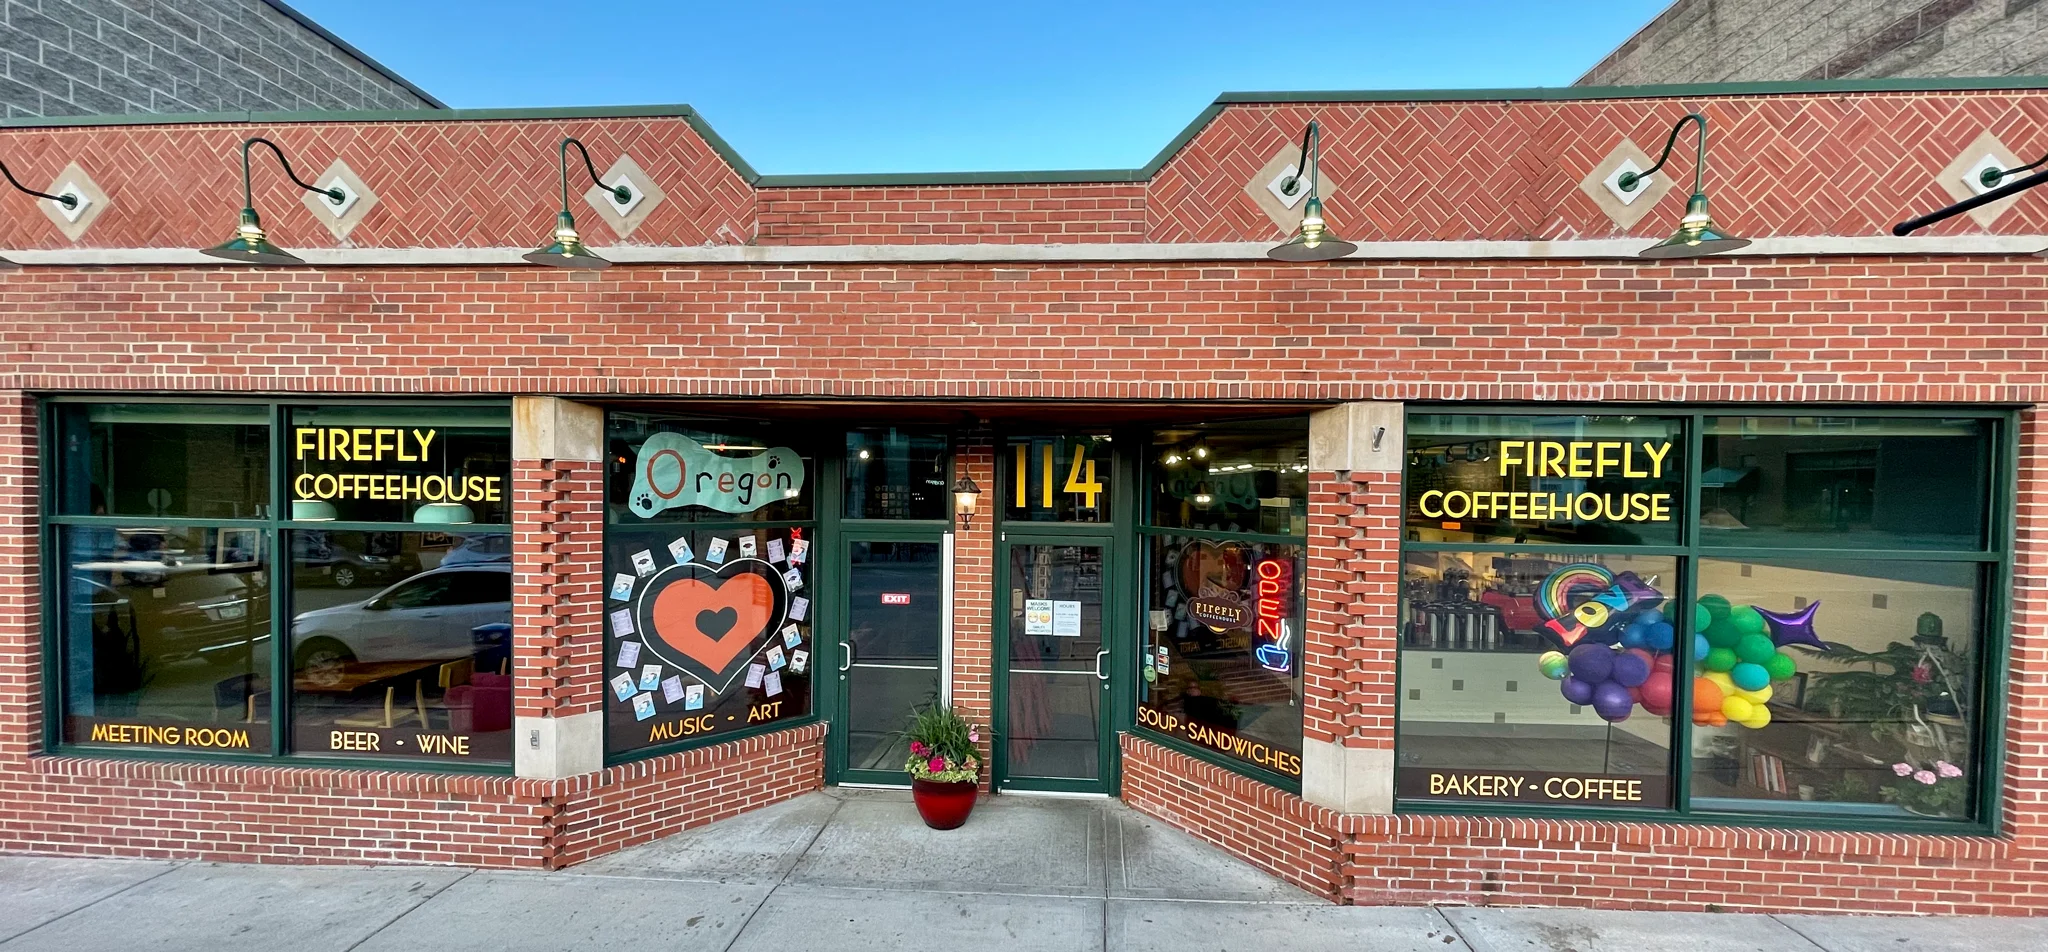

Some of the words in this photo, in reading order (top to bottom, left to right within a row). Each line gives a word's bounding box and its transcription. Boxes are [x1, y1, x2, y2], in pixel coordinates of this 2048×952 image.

[296, 428, 436, 462] FIREFLY
[1500, 441, 1671, 478] FIREFLY
[295, 473, 501, 502] COFFEEHOUSE
[646, 448, 792, 505] Oregon
[1016, 444, 1102, 508] 114
[1419, 490, 1670, 521] COFFEEHOUSE
[884, 595, 908, 603] EXIT
[1257, 560, 1281, 640] OPEN
[1199, 612, 1236, 623] COFFEEHOUSE
[91, 724, 180, 747] MEETING
[185, 726, 250, 749] ROOM
[649, 713, 715, 742] MUSIC
[747, 701, 782, 723] ART
[330, 731, 380, 752] BEER
[416, 733, 470, 755] WINE
[1138, 706, 1177, 731] SOUP
[1188, 722, 1301, 776] SANDWICHES
[1430, 774, 1525, 797] BAKERY
[1544, 777, 1642, 801] COFFEE
